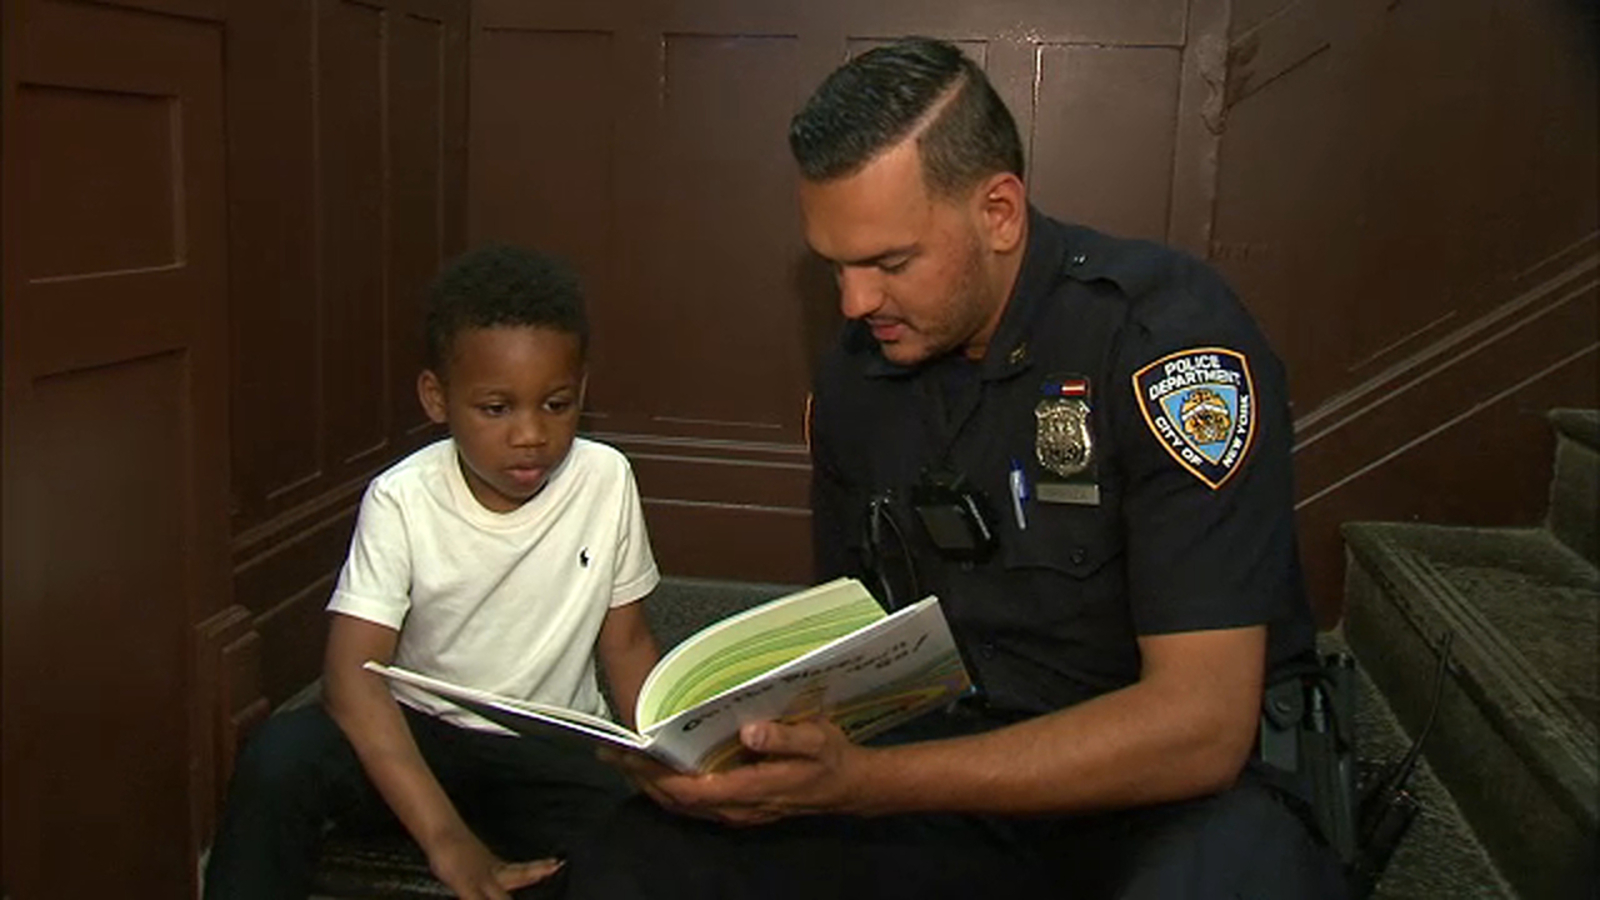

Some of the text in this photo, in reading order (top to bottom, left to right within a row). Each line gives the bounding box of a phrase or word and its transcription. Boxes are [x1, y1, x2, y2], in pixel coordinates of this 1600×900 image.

[1148, 370, 1241, 401] DEPARTMENT
[1164, 355, 1221, 376] POLICE
[1155, 416, 1203, 466] CITY OF
[1222, 394, 1249, 468] NEW YORK
